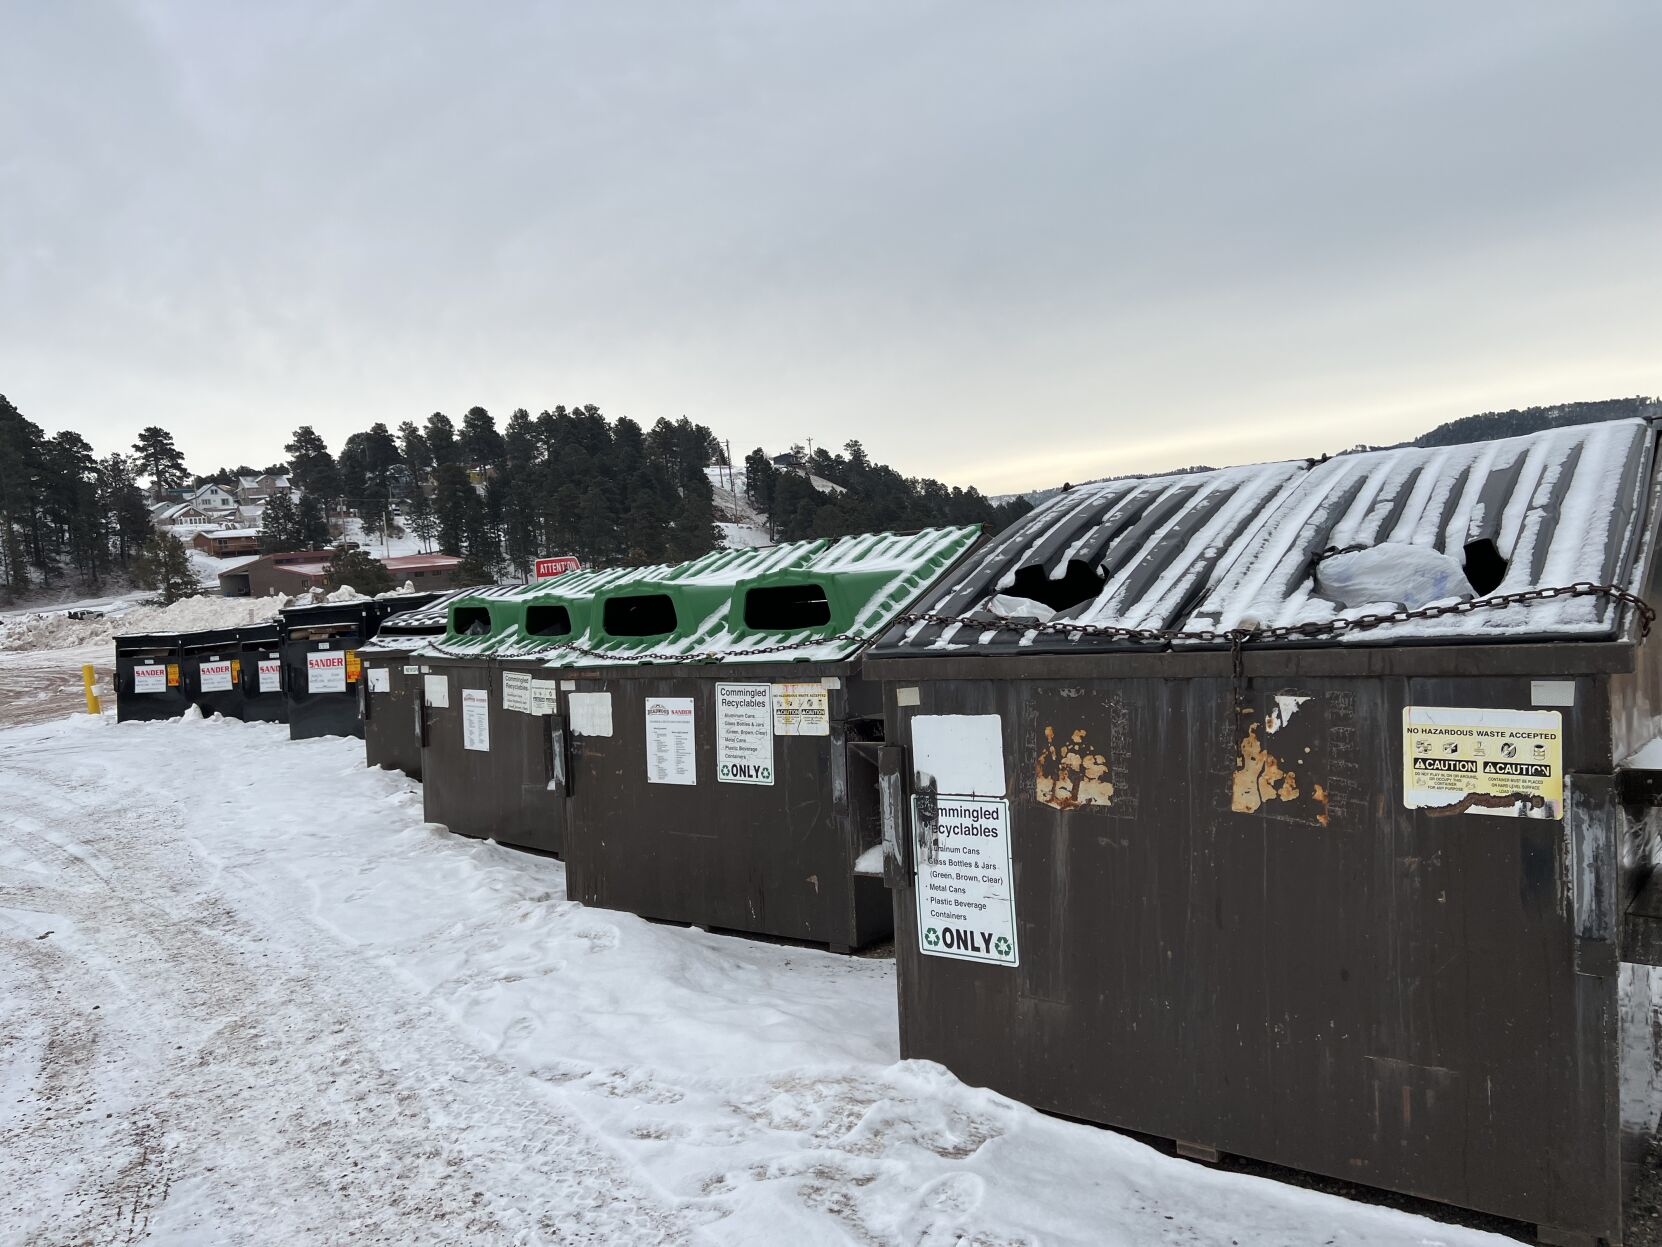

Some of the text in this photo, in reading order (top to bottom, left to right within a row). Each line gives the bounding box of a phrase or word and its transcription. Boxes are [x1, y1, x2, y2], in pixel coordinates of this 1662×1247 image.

[309, 657, 344, 668] SANDER
[136, 669, 165, 677] SANDER
[202, 665, 230, 675] SANDER
[720, 688, 767, 698] Commingled
[721, 698, 766, 708] Recyclables
[1421, 728, 1474, 737] HAZARDOUS
[1476, 730, 1506, 738] WASTE
[1508, 731, 1557, 740] ACCEPTED
[731, 763, 760, 778] ONLY
[1425, 759, 1476, 772] CAUTION
[1496, 763, 1550, 776] CAUTION
[938, 805, 1000, 823] mmingled
[931, 822, 999, 838] ecyclables
[962, 846, 980, 856] Cans
[948, 858, 973, 868] Bottles
[974, 861, 980, 869] &
[981, 862, 997, 870] Jars
[930, 870, 1003, 886] (Green, Brown, Clear)
[929, 884, 966, 894] Metal Cans
[930, 896, 987, 911] Plastic Beverage
[930, 909, 967, 921] Containers
[941, 926, 994, 954] ONLY
